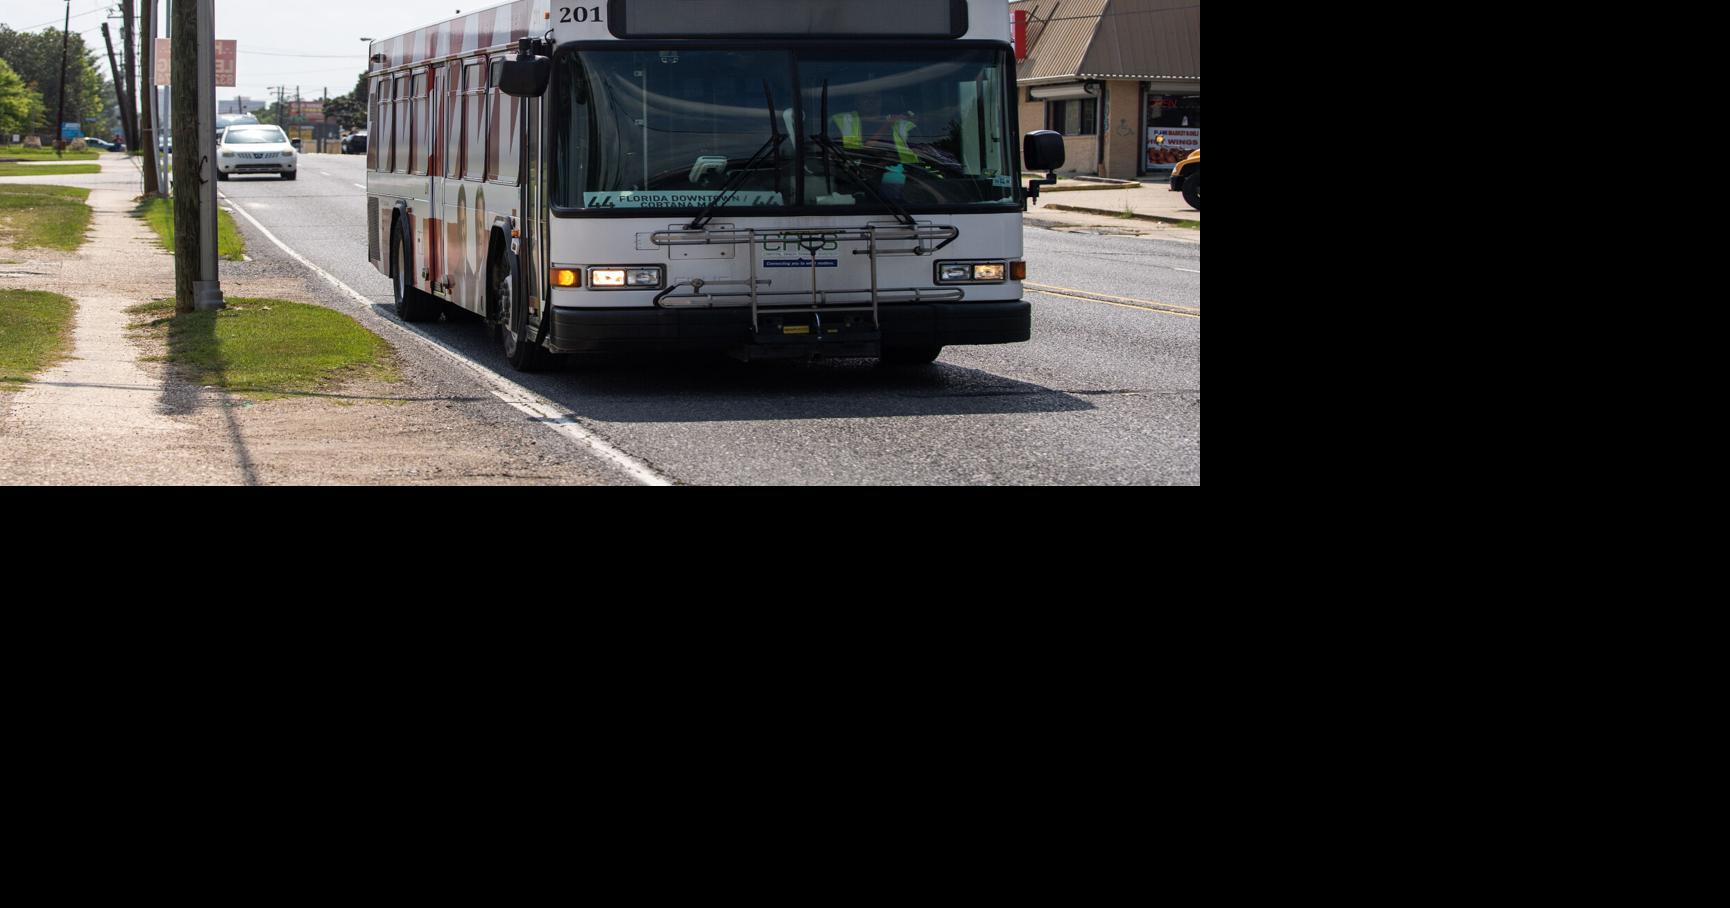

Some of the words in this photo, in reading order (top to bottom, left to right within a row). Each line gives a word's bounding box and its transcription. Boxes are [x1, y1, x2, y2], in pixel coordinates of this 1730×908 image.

[559, 6, 603, 23] 201
[587, 195, 616, 208] 44
[619, 195, 669, 203] FLORIDA
[751, 195, 780, 207] 44
